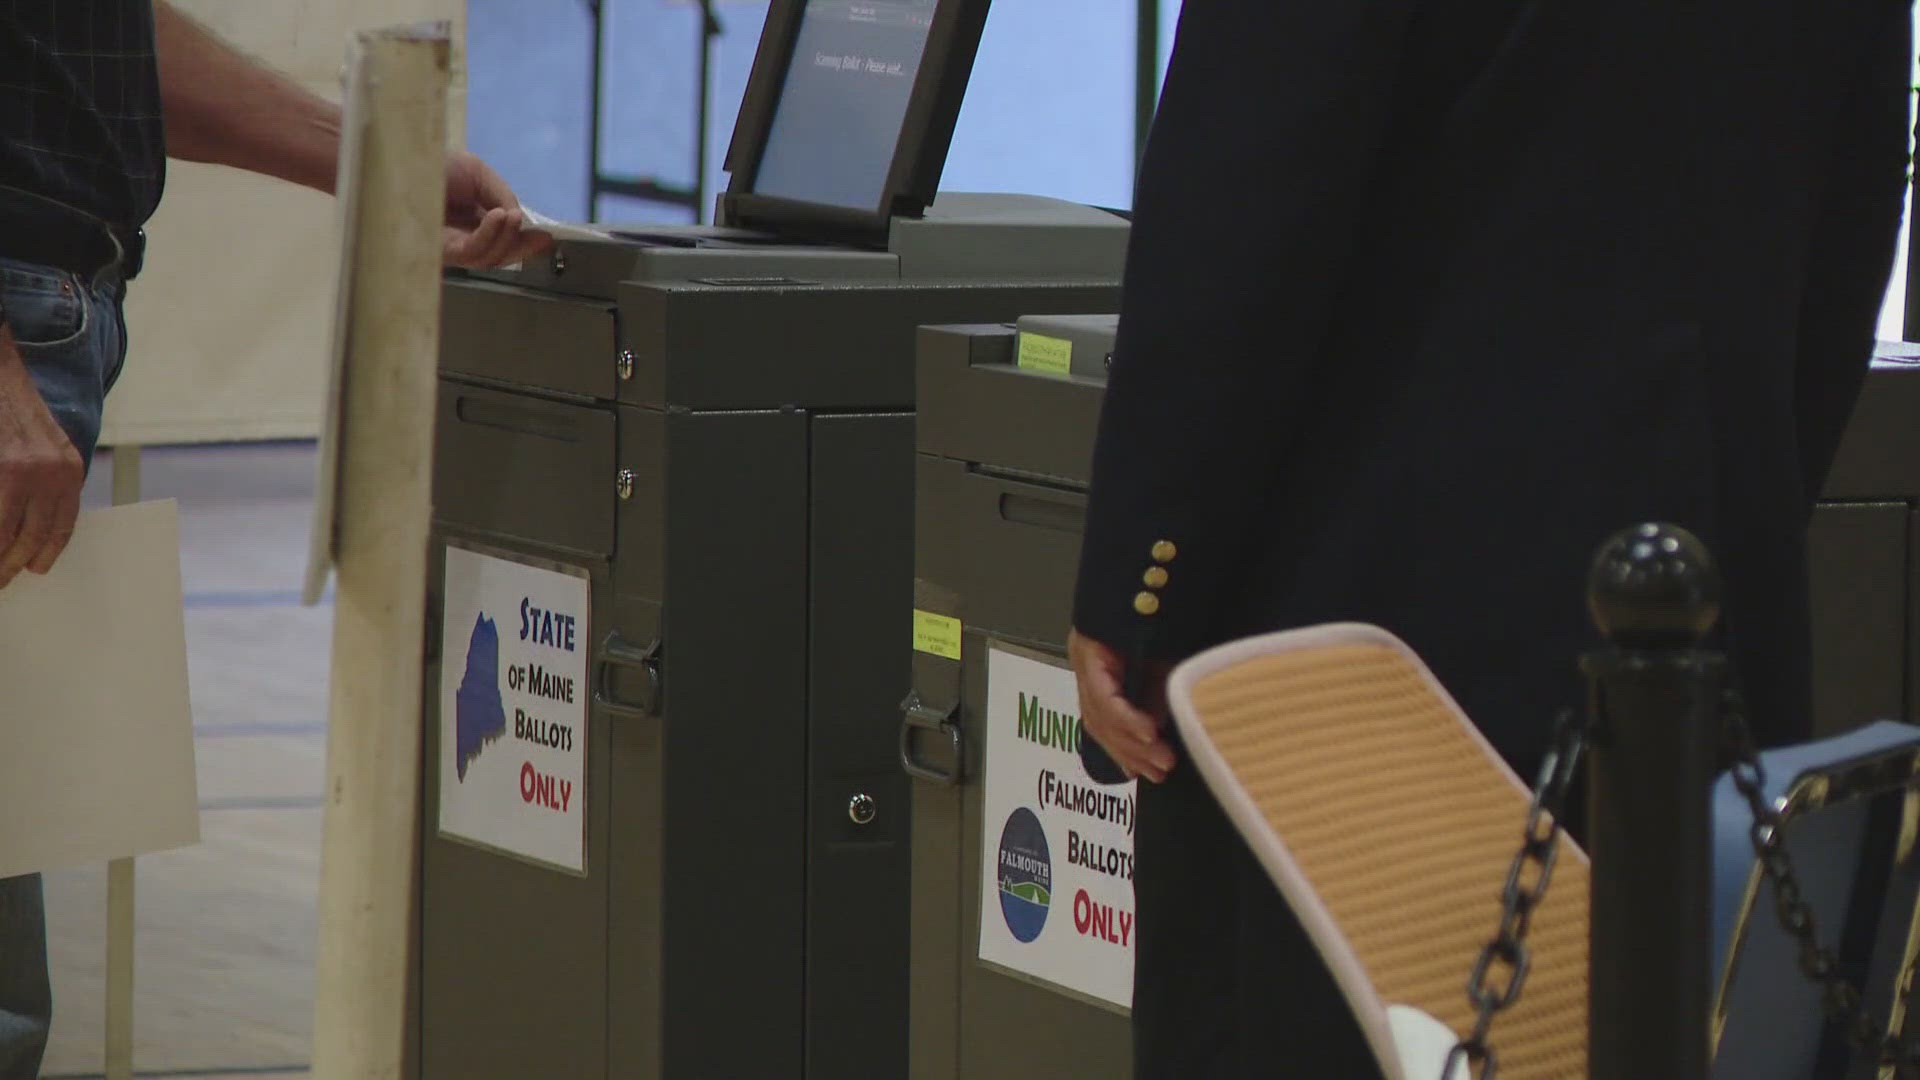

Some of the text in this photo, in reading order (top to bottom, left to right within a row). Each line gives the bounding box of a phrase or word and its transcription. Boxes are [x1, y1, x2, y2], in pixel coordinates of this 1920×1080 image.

[519, 596, 575, 652] STATE
[508, 663, 574, 704] OF MAINE
[515, 708, 573, 752] BALLOTS
[520, 760, 572, 813] ONLY
[1038, 769, 1135, 835] (FALMOUTH)
[1000, 849, 1049, 877] FALMOUTH
[1067, 829, 1134, 881] BALLOTS
[1073, 888, 1132, 947] ONLY
